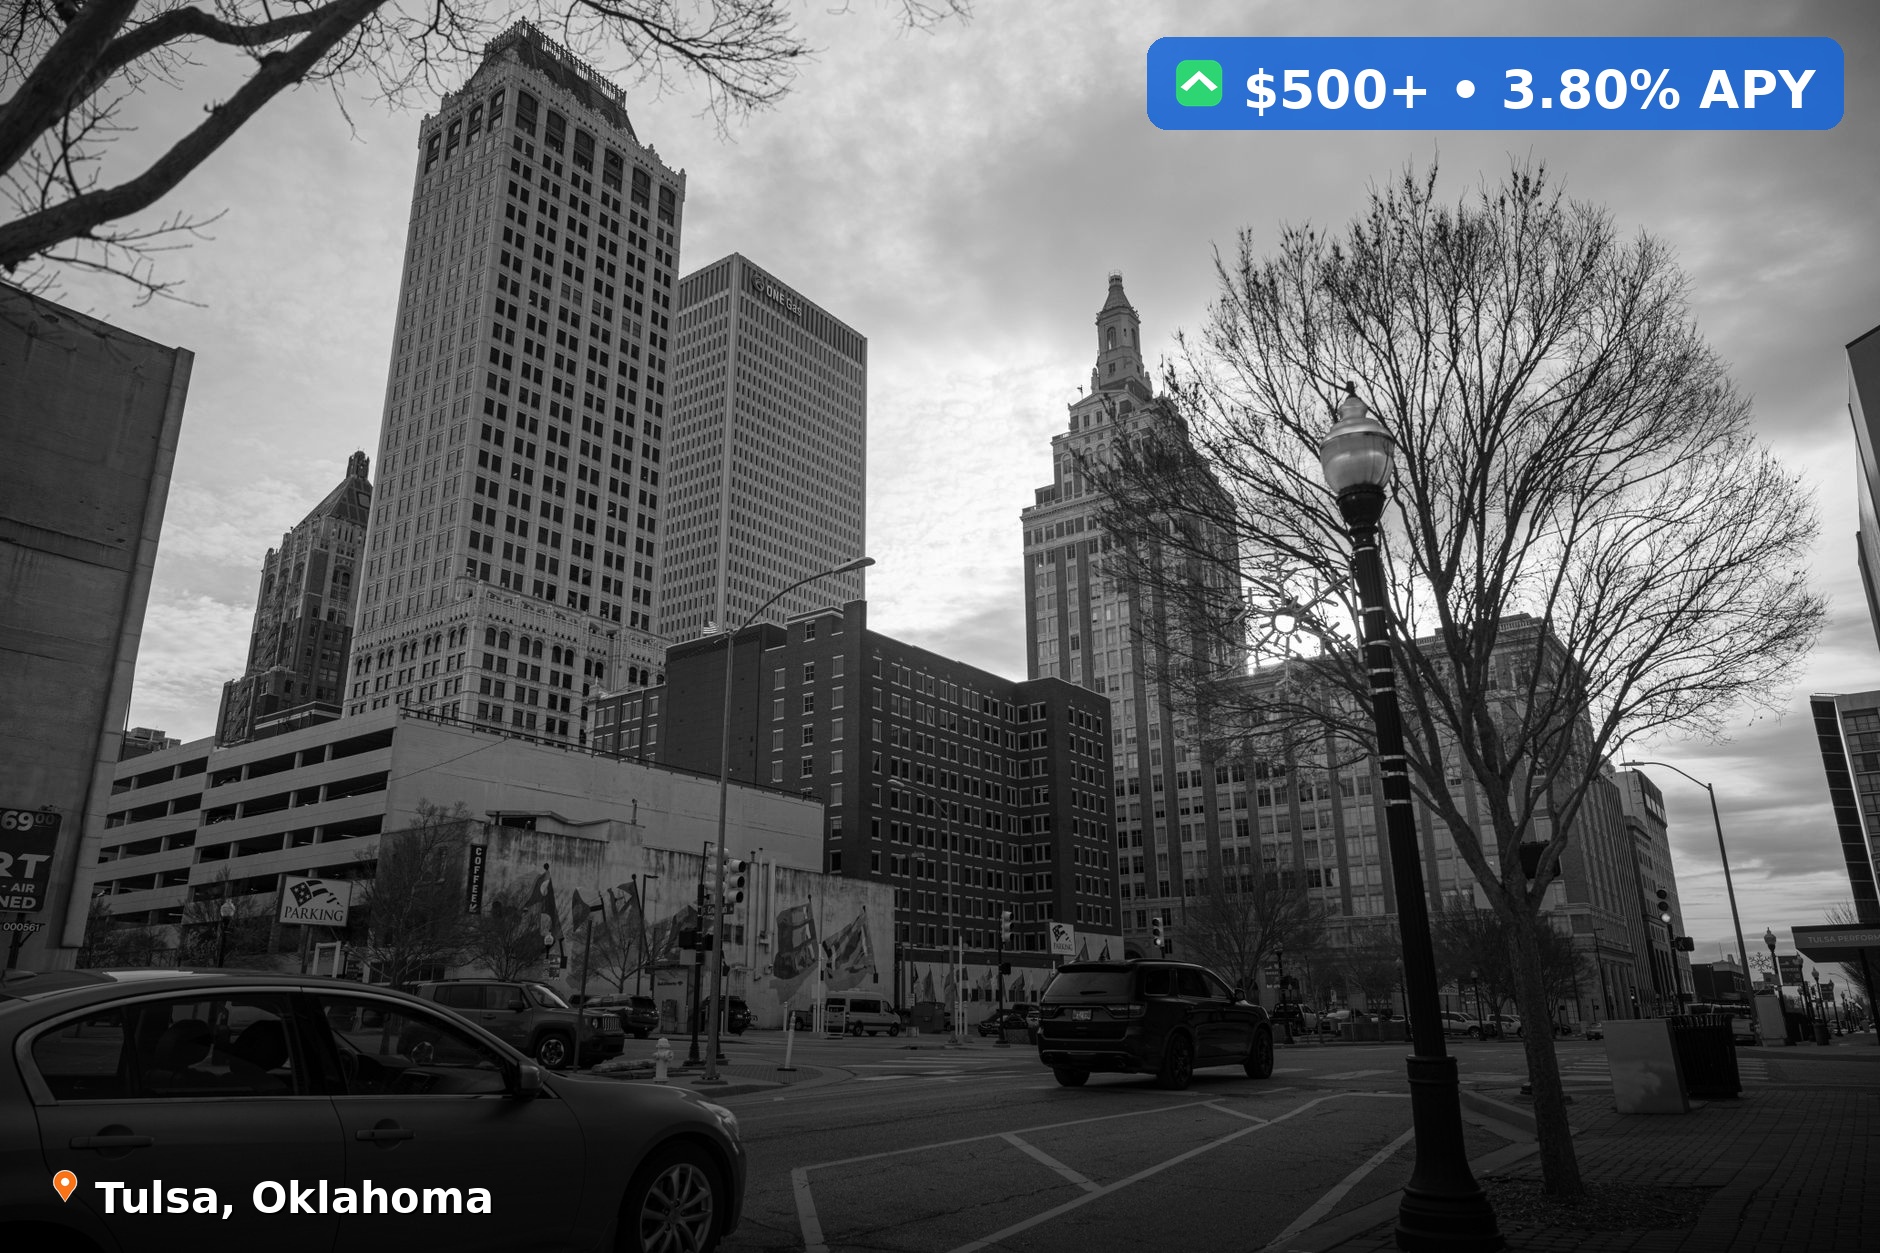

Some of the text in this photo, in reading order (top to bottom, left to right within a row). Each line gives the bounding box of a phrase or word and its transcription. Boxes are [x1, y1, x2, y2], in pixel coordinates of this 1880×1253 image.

[766, 285, 785, 306] ONE
[471, 847, 482, 902] COFFEE
[10, 883, 35, 893] AIR
[284, 906, 344, 922] PARKING
[3, 922, 41, 932] 000561
